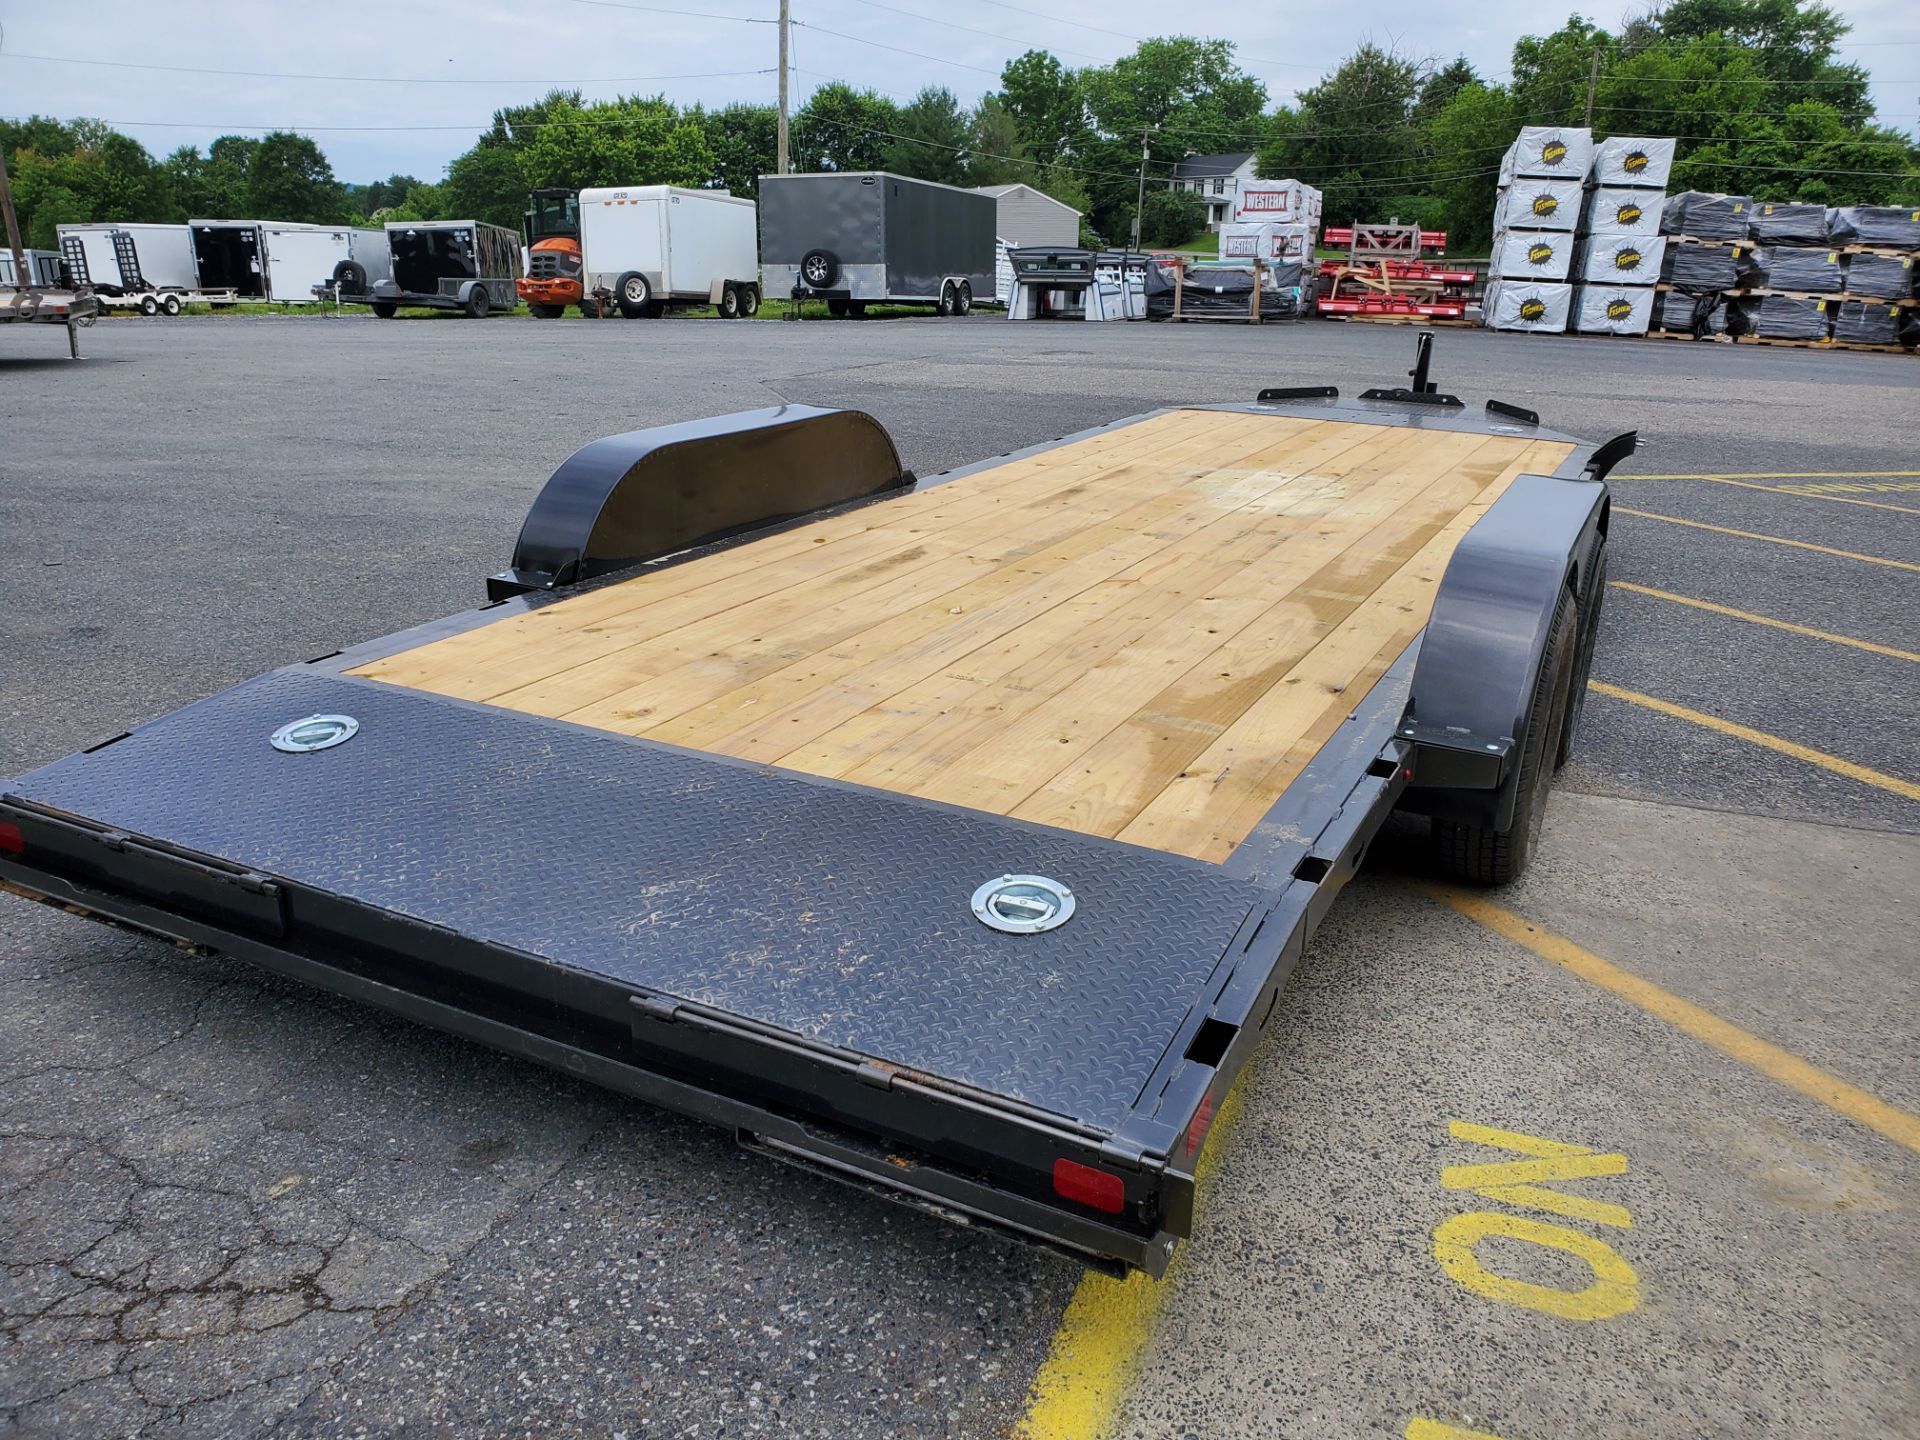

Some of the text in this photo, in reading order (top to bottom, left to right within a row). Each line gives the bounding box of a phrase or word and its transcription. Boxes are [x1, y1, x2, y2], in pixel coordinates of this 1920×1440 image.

[1246, 193, 1285, 210] WESTERN
[1228, 238, 1257, 254] WESTERN
[1433, 1120, 1641, 1321] NO
